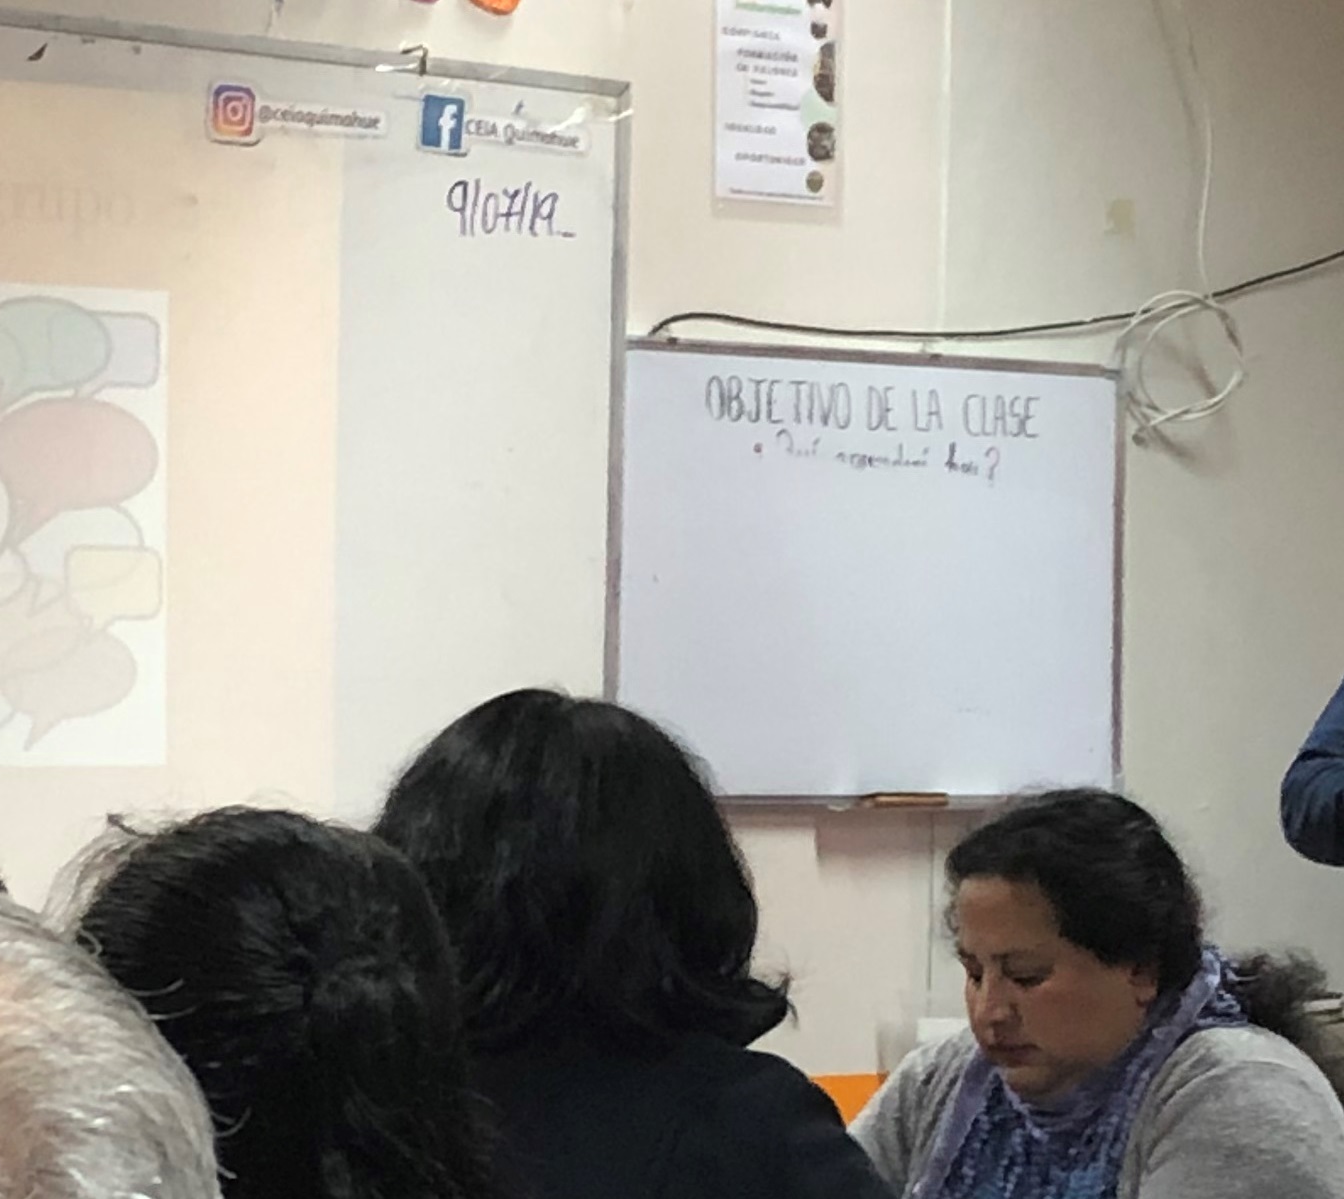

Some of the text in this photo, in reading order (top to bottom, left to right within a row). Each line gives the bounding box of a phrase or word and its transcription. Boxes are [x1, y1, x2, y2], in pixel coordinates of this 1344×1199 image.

[707, 375, 1041, 438] OBJETIVO DE LA CLASE
